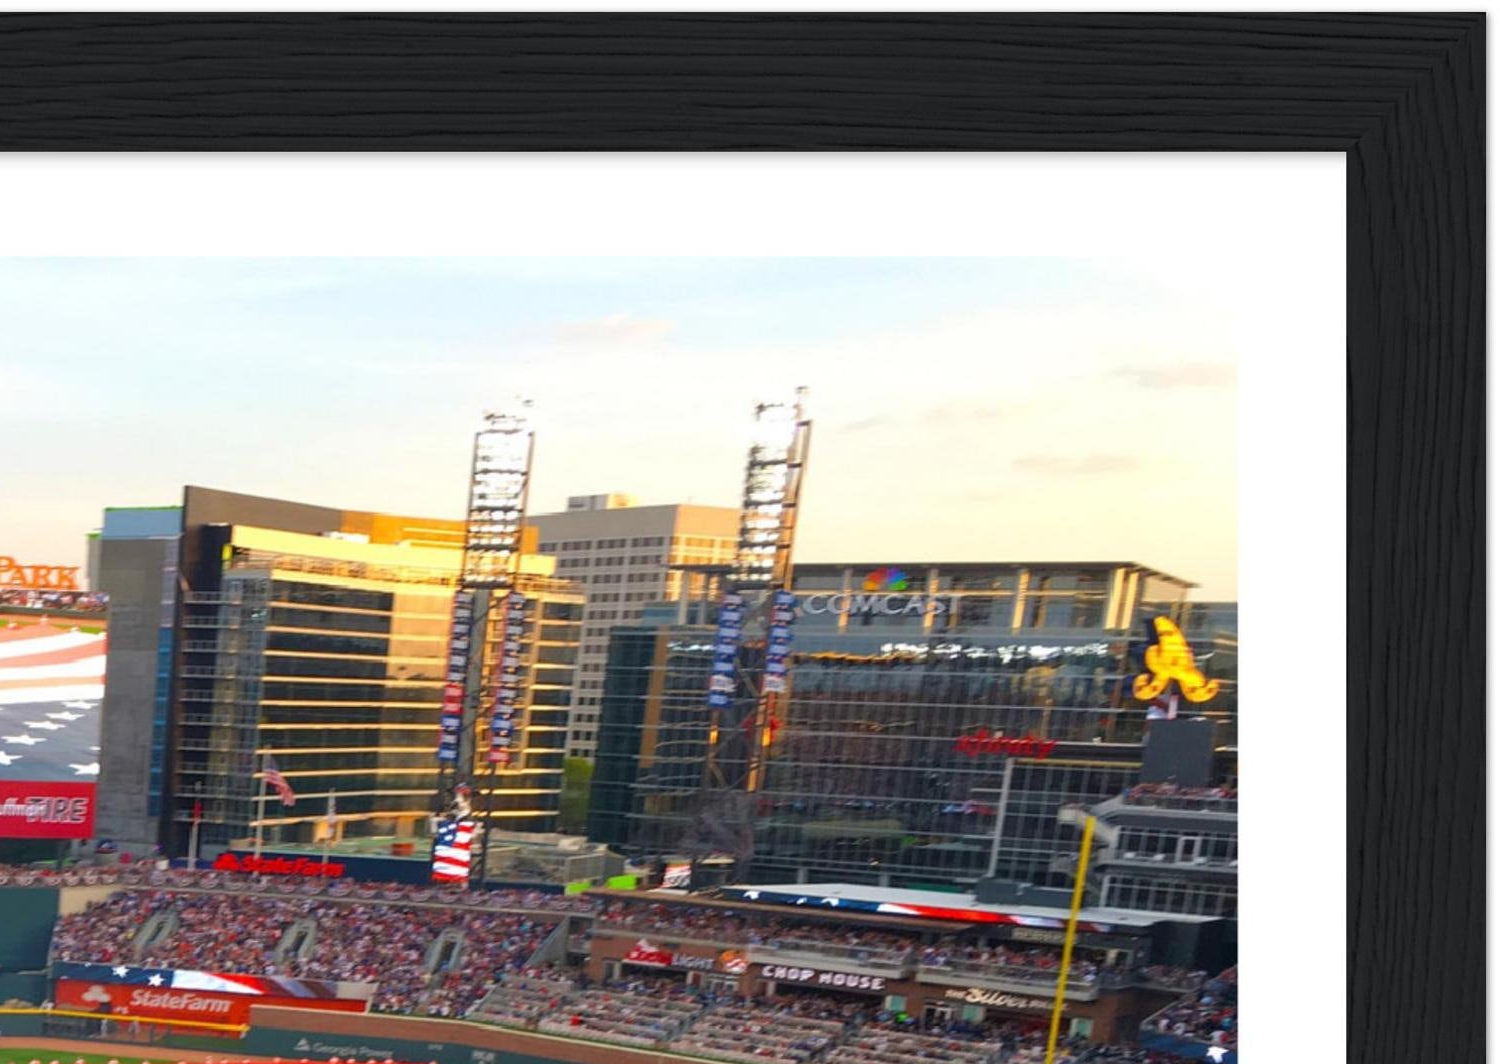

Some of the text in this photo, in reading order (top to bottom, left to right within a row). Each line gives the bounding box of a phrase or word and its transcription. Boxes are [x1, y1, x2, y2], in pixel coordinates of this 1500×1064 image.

[801, 594, 963, 617] COMCAST
[24, 796, 89, 824] TIRE
[762, 965, 886, 990] CHOP HOUSE
